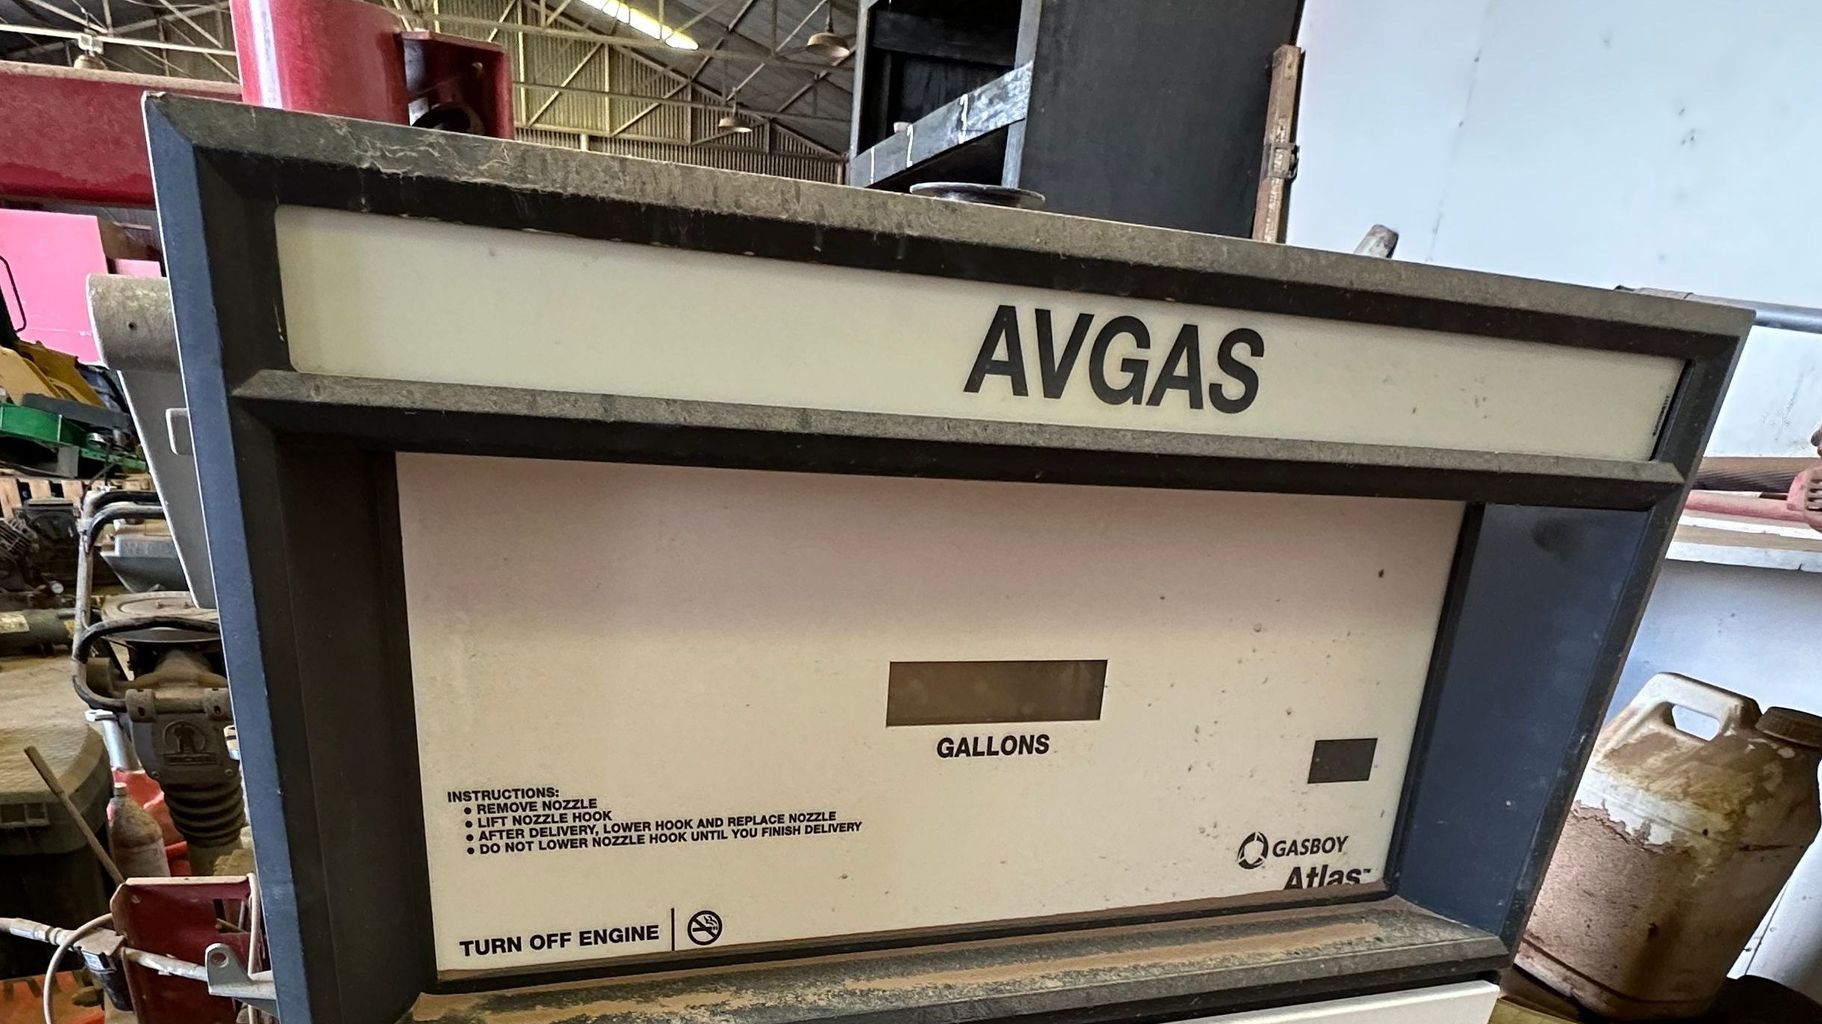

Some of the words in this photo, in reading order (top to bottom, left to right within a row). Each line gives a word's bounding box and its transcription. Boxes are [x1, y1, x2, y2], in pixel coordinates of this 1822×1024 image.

[963, 304, 1265, 414] AVGAS
[937, 734, 1050, 758] GALLONS
[447, 787, 560, 803] INSTRUCTIONS:
[476, 801, 538, 815] REMOVE
[542, 798, 598, 812] NOZZLE
[477, 816, 508, 828] LIFT
[512, 813, 568, 826] NOZZLE
[572, 810, 612, 823] HOOK
[478, 828, 525, 841] AFTER
[529, 824, 599, 838] DELIVERY,
[603, 821, 652, 834] LOWER
[655, 819, 694, 831] HOOK
[697, 817, 724, 829] AND
[727, 814, 785, 827] REPLACE
[789, 811, 837, 824] NOZZLE
[479, 843, 501, 854] DO
[505, 841, 534, 853] NOT
[538, 837, 588, 850] LOWER
[592, 834, 645, 847] NOZZLE
[649, 832, 688, 844] HOOK
[691, 830, 728, 841] UNTIL
[732, 828, 758, 839] YOU
[761, 825, 801, 837] FINISH
[804, 821, 862, 834] DELIVERY
[1272, 835, 1349, 857] GASBOY
[459, 936, 522, 957] TURN
[529, 932, 572, 951] OFF
[579, 924, 660, 947] ENGINE
